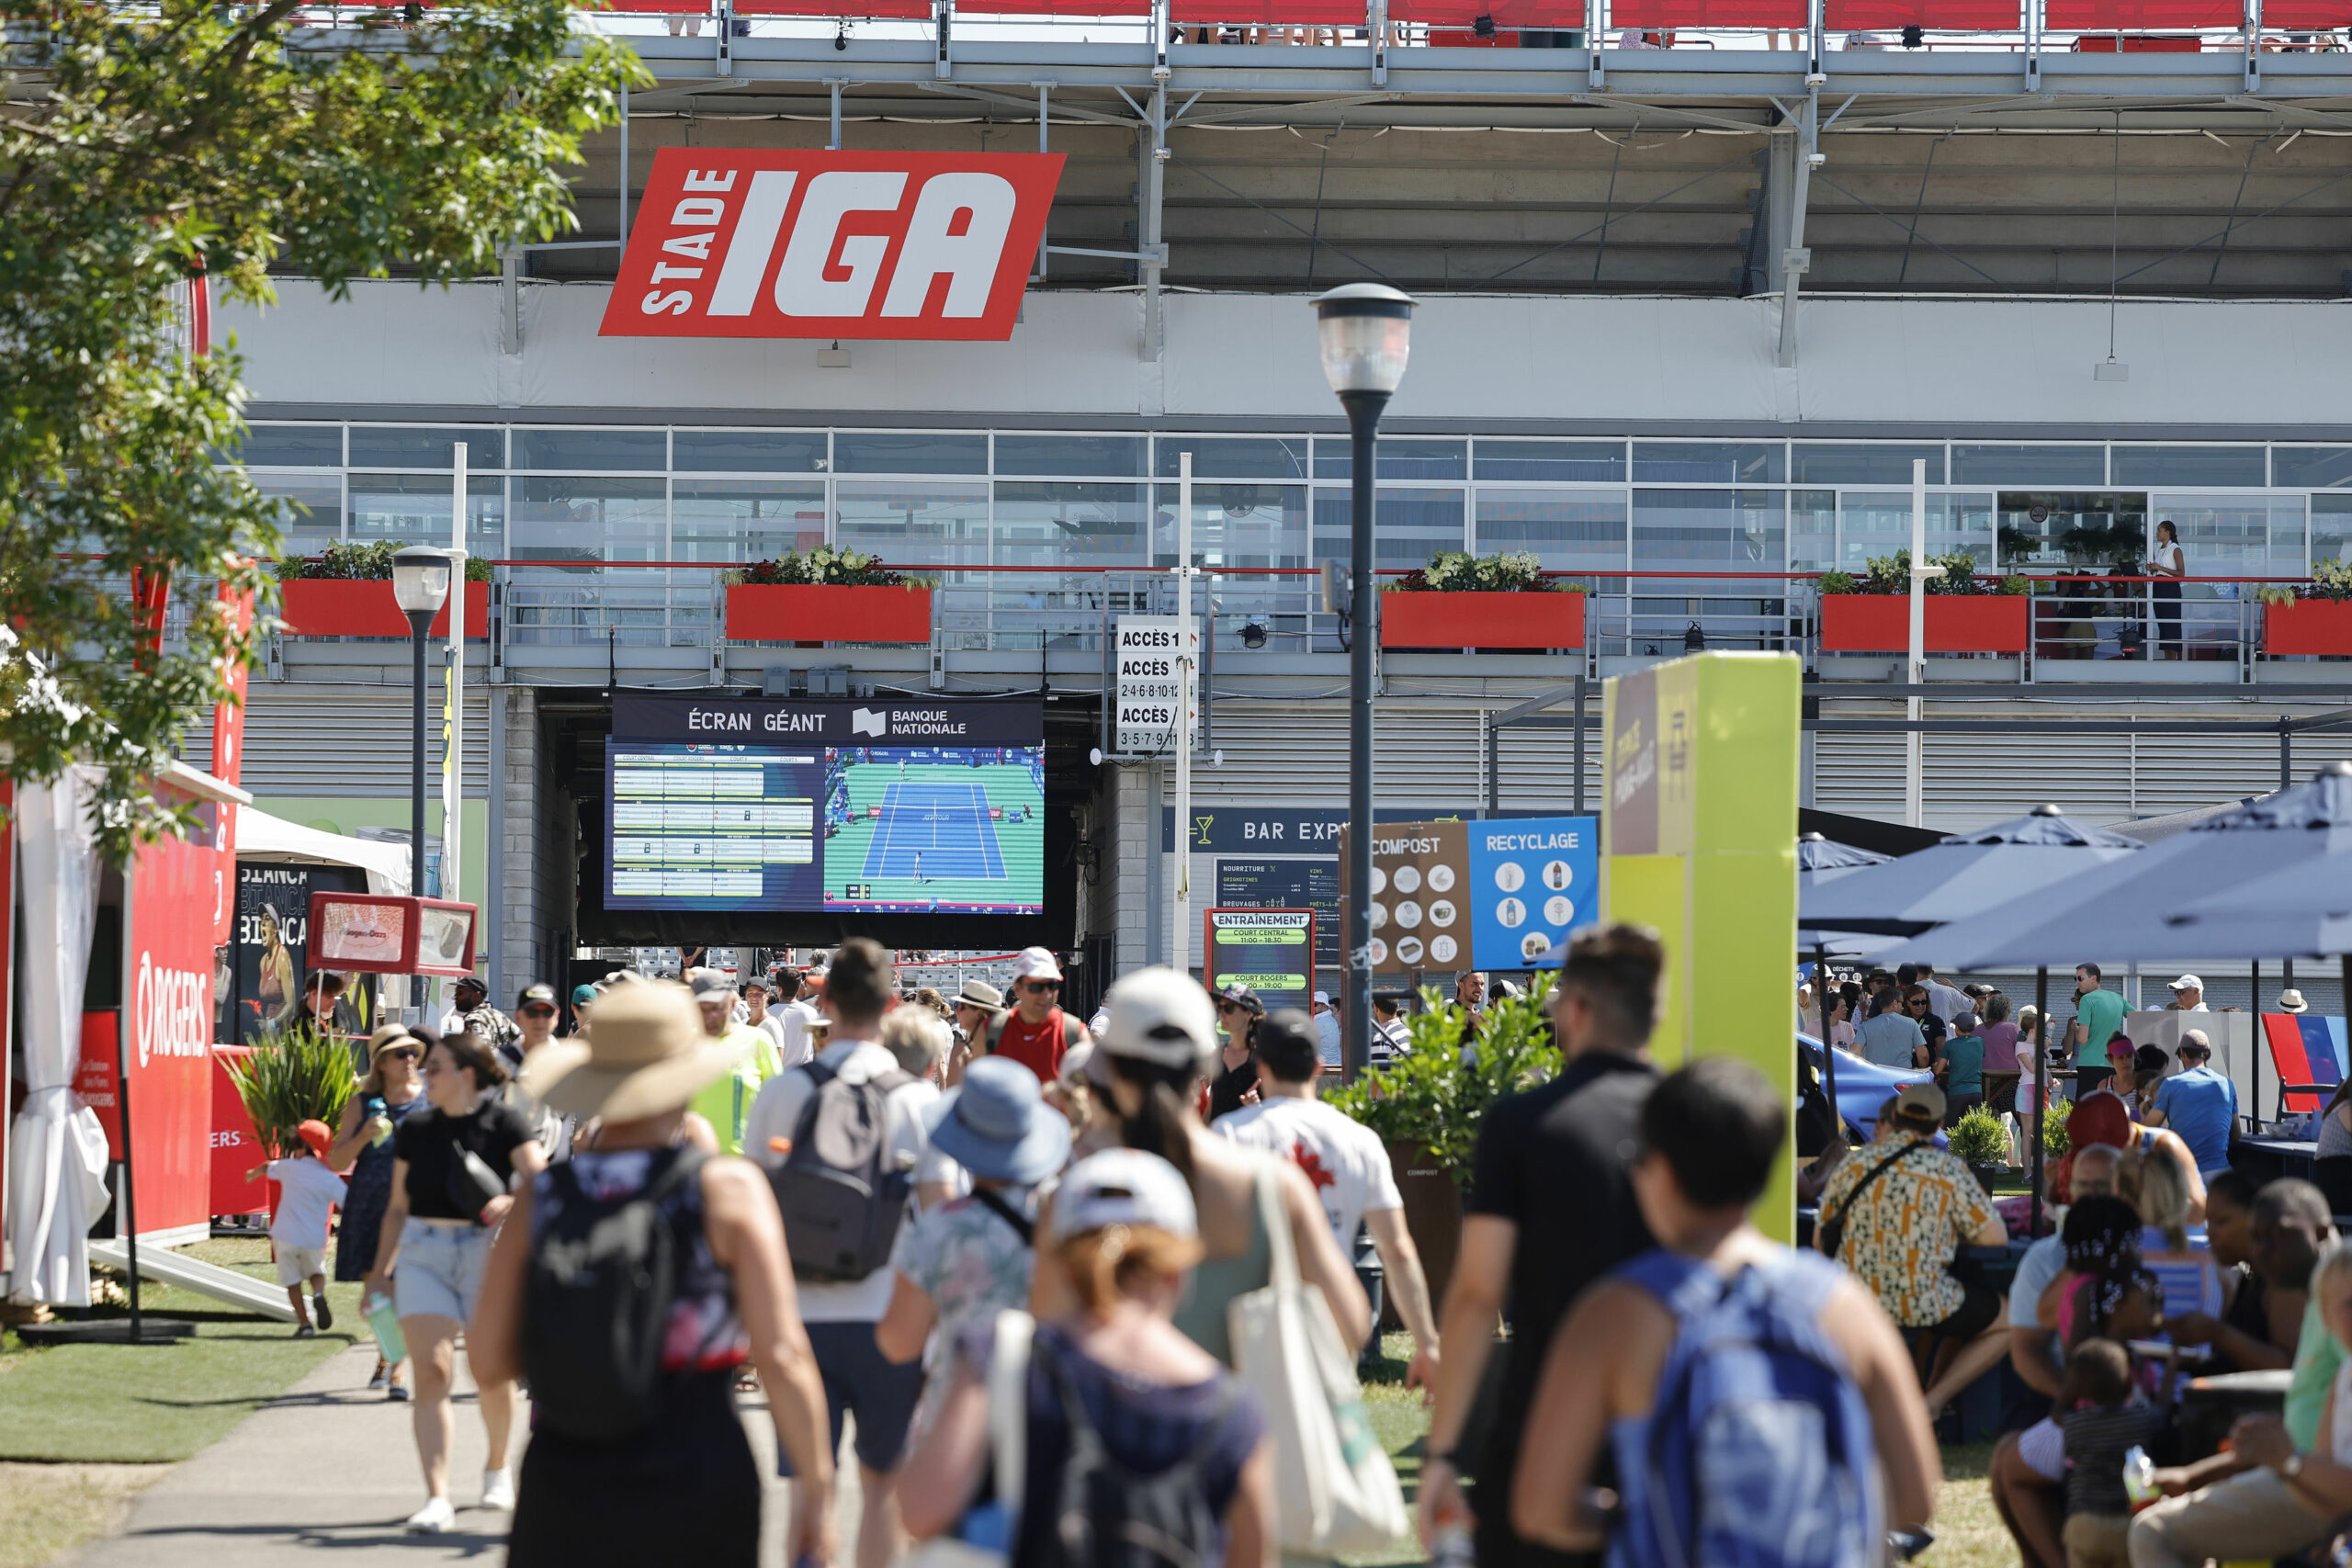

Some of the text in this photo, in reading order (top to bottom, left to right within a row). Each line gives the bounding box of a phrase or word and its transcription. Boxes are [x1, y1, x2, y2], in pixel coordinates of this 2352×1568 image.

[641, 169, 738, 316] STADE
[706, 170, 1017, 318] IGA
[1122, 628, 1169, 647] ACCÈS
[1122, 658, 1169, 676] ACCÈS
[688, 706, 826, 732] ÉCRAN GÉANT
[892, 711, 947, 722] BANQUE
[1121, 705, 1169, 724] ACCÈS
[892, 723, 966, 735] NATIONALE
[1244, 822, 1284, 840] BAR
[1372, 836, 1441, 855] COMPOST
[1486, 832, 1579, 852] RECYCLAGE
[1218, 913, 1305, 925] ENTRAÎNEMENT
[240, 915, 307, 946] BINCA
[153, 966, 207, 1058] ROGERS
